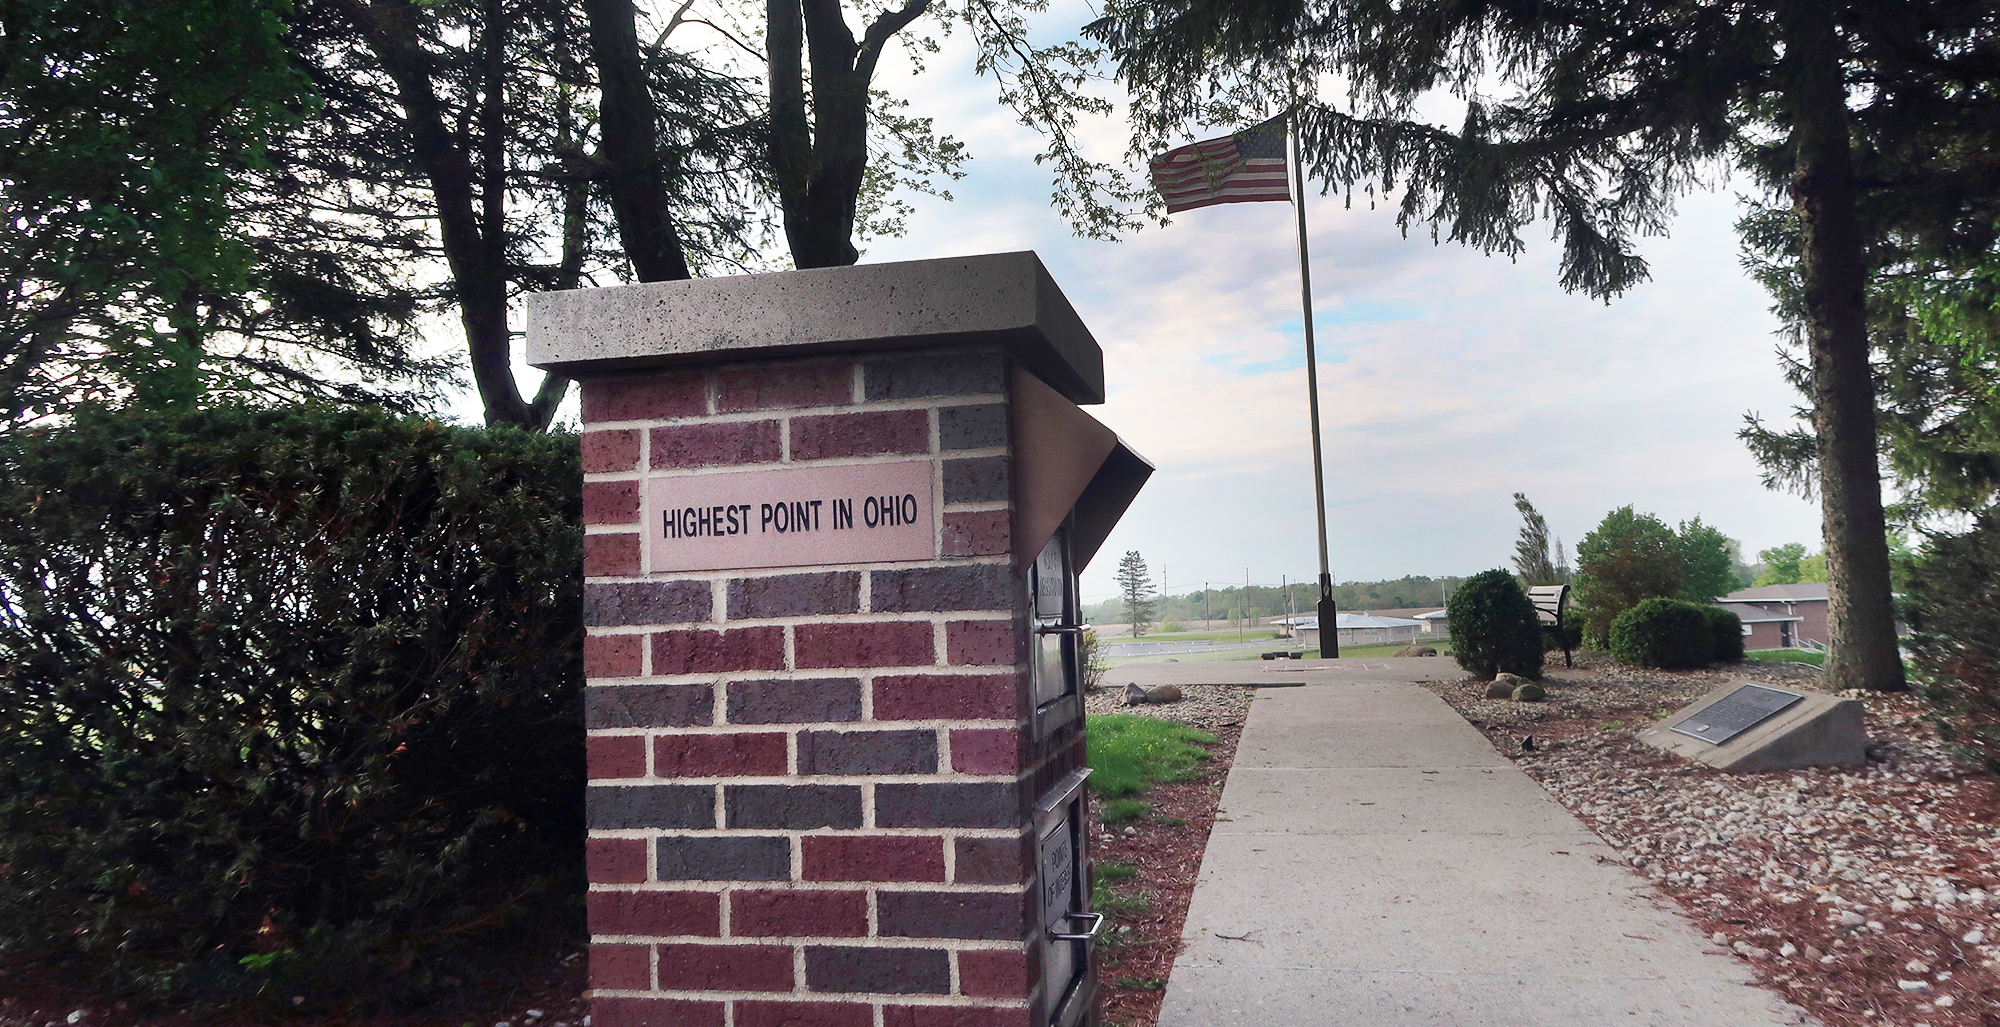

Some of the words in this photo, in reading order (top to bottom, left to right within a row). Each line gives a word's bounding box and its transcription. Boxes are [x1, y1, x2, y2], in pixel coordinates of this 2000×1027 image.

[662, 505, 751, 539] HIGHEST
[761, 500, 822, 533] POINT
[833, 498, 853, 530] IN
[864, 494, 918, 528] OHIO
